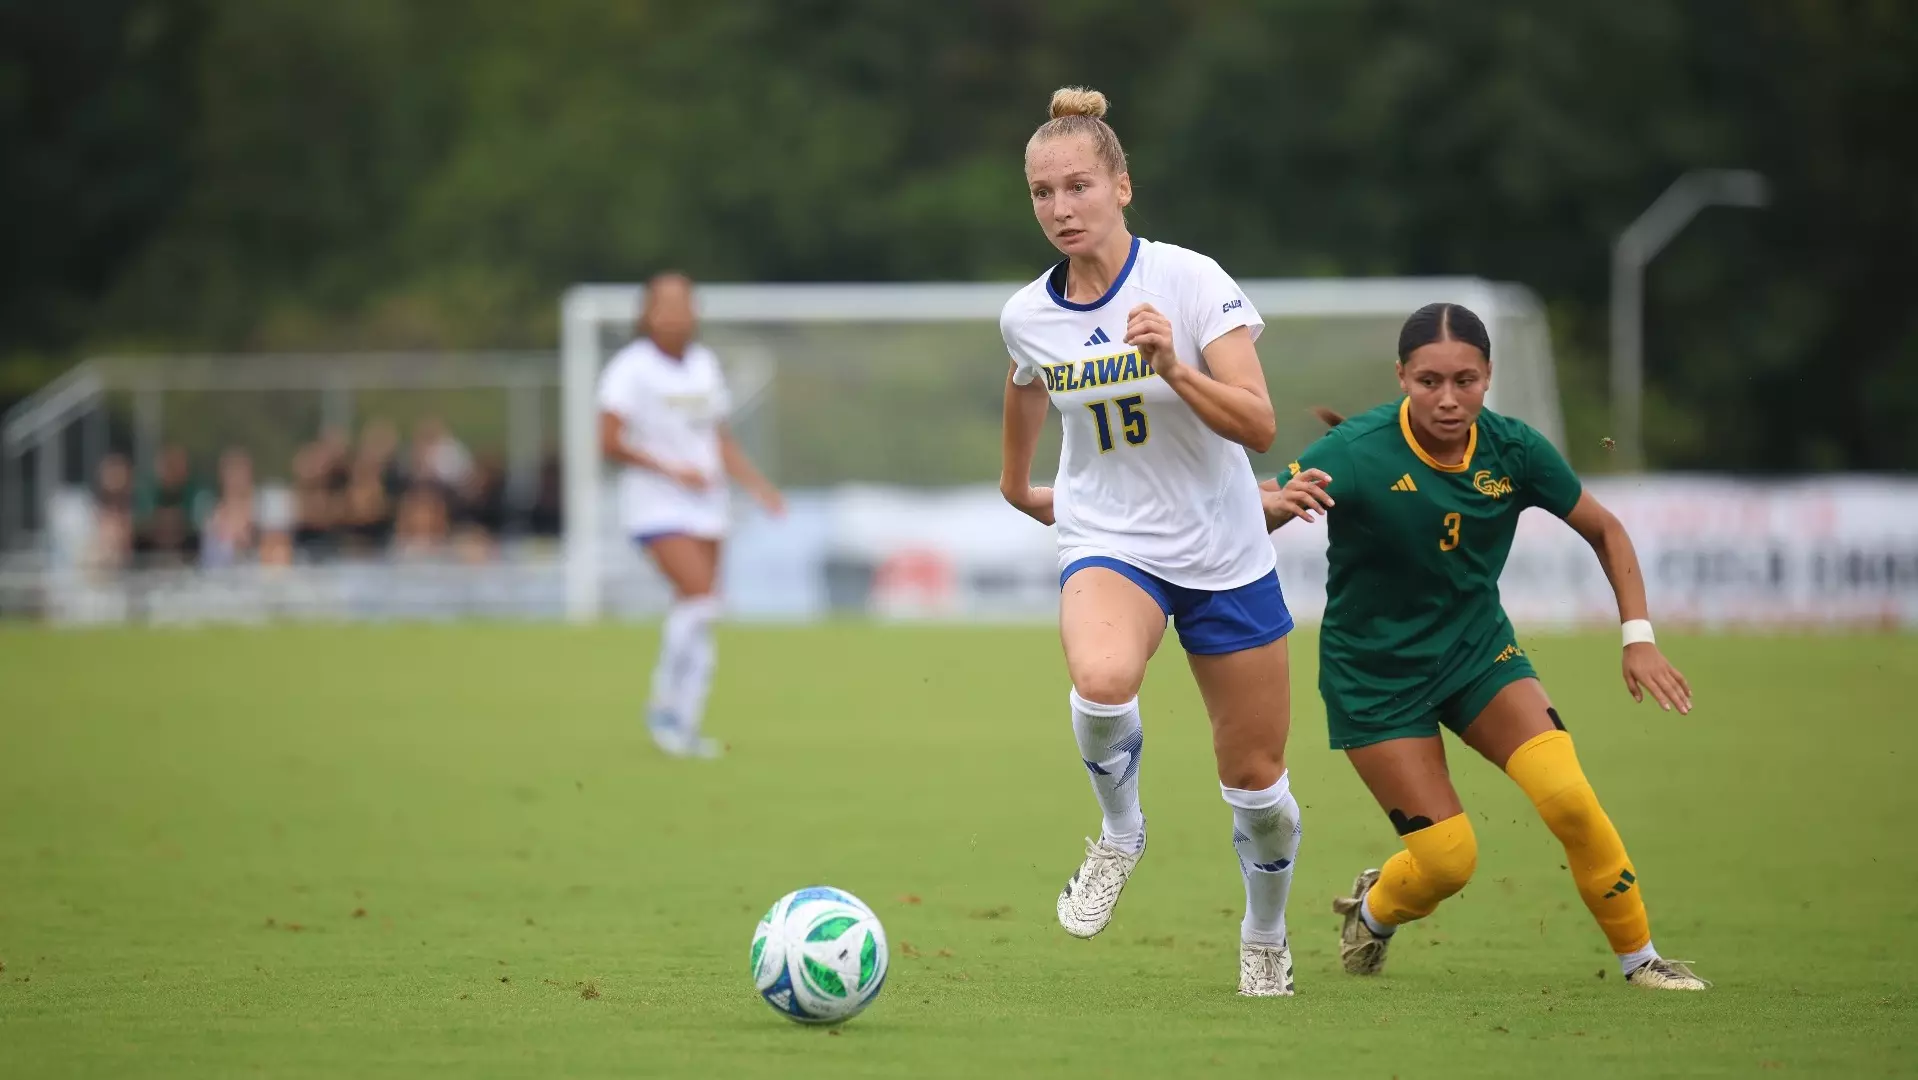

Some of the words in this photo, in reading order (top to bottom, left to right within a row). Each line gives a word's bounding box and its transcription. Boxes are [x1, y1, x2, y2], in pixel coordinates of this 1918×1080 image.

[1041, 350, 1157, 392] DELAWA
[1084, 393, 1150, 454] 15
[1440, 512, 1461, 551] 3
